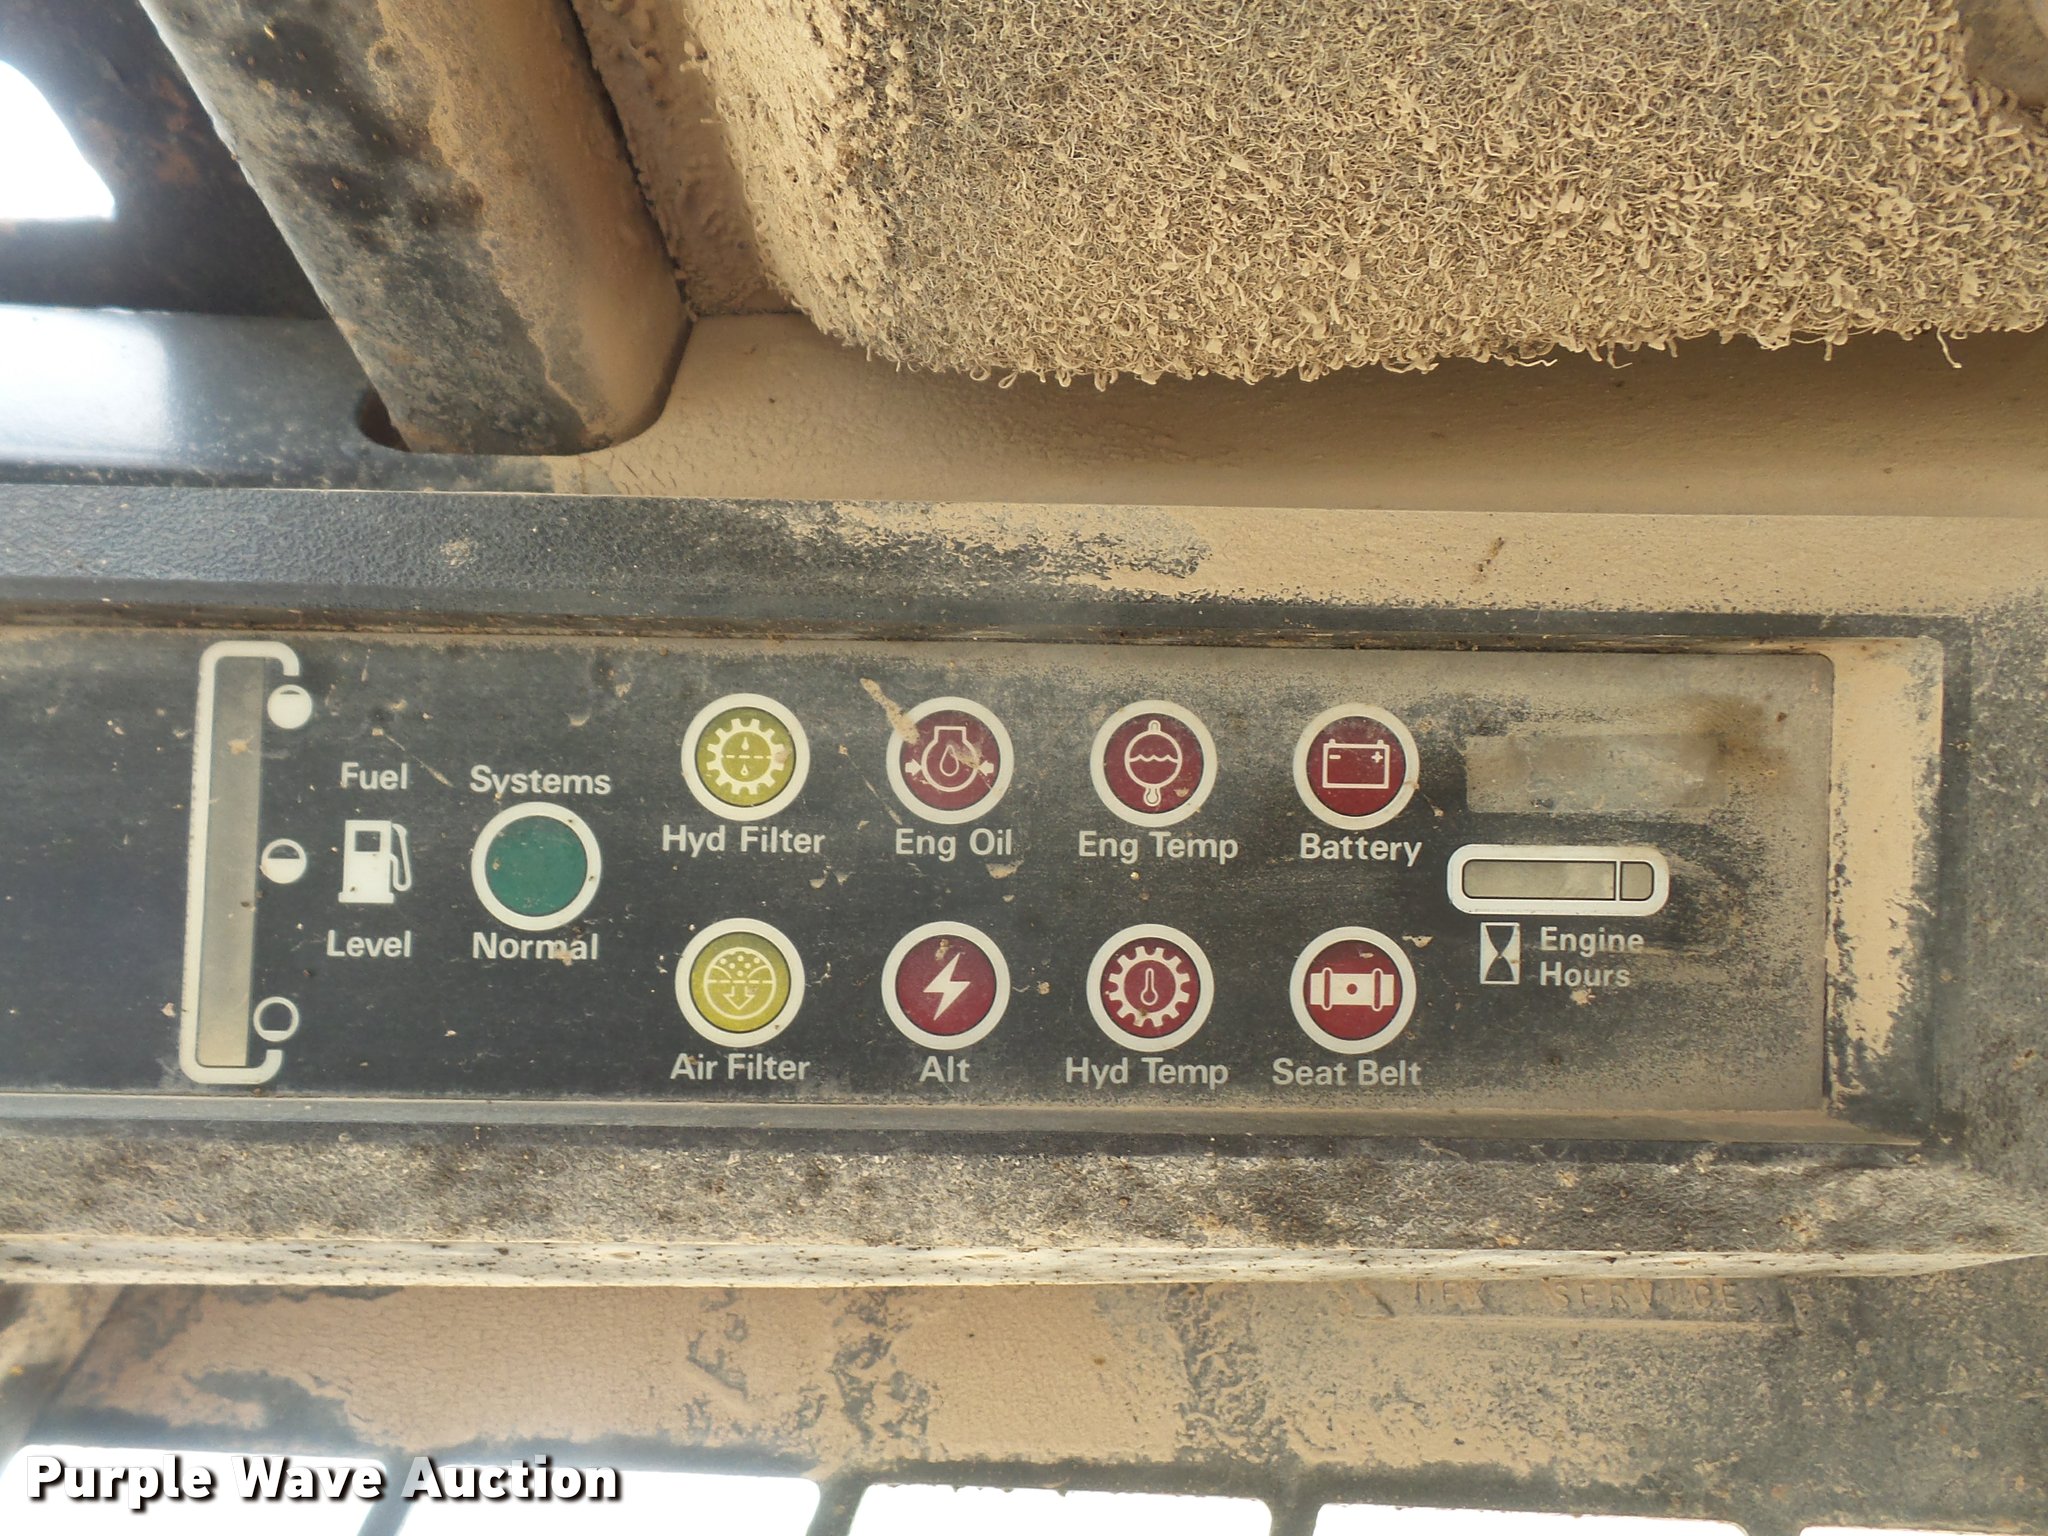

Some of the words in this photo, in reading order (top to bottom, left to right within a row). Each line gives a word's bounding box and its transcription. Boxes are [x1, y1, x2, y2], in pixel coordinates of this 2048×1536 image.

[340, 762, 408, 790] Fuel
[470, 765, 612, 797] Systems
[662, 825, 726, 858] Hyd
[741, 826, 826, 855] Filter
[896, 828, 957, 862] Eng
[969, 828, 1012, 856] Oil
[1078, 831, 1139, 864] Eng
[1148, 831, 1239, 865] Temp
[1299, 833, 1423, 867] Battery
[326, 930, 412, 958] Level
[472, 931, 599, 961] Normal
[1540, 926, 1645, 956] Engine
[1540, 962, 1631, 989] Hours
[670, 1053, 719, 1080] Air
[727, 1053, 811, 1081] Filter
[919, 1055, 971, 1083] Alt
[1065, 1057, 1129, 1090] Hyd
[1140, 1057, 1229, 1091] Temp
[1272, 1058, 1348, 1087] Seat
[1357, 1060, 1422, 1088] Belt
